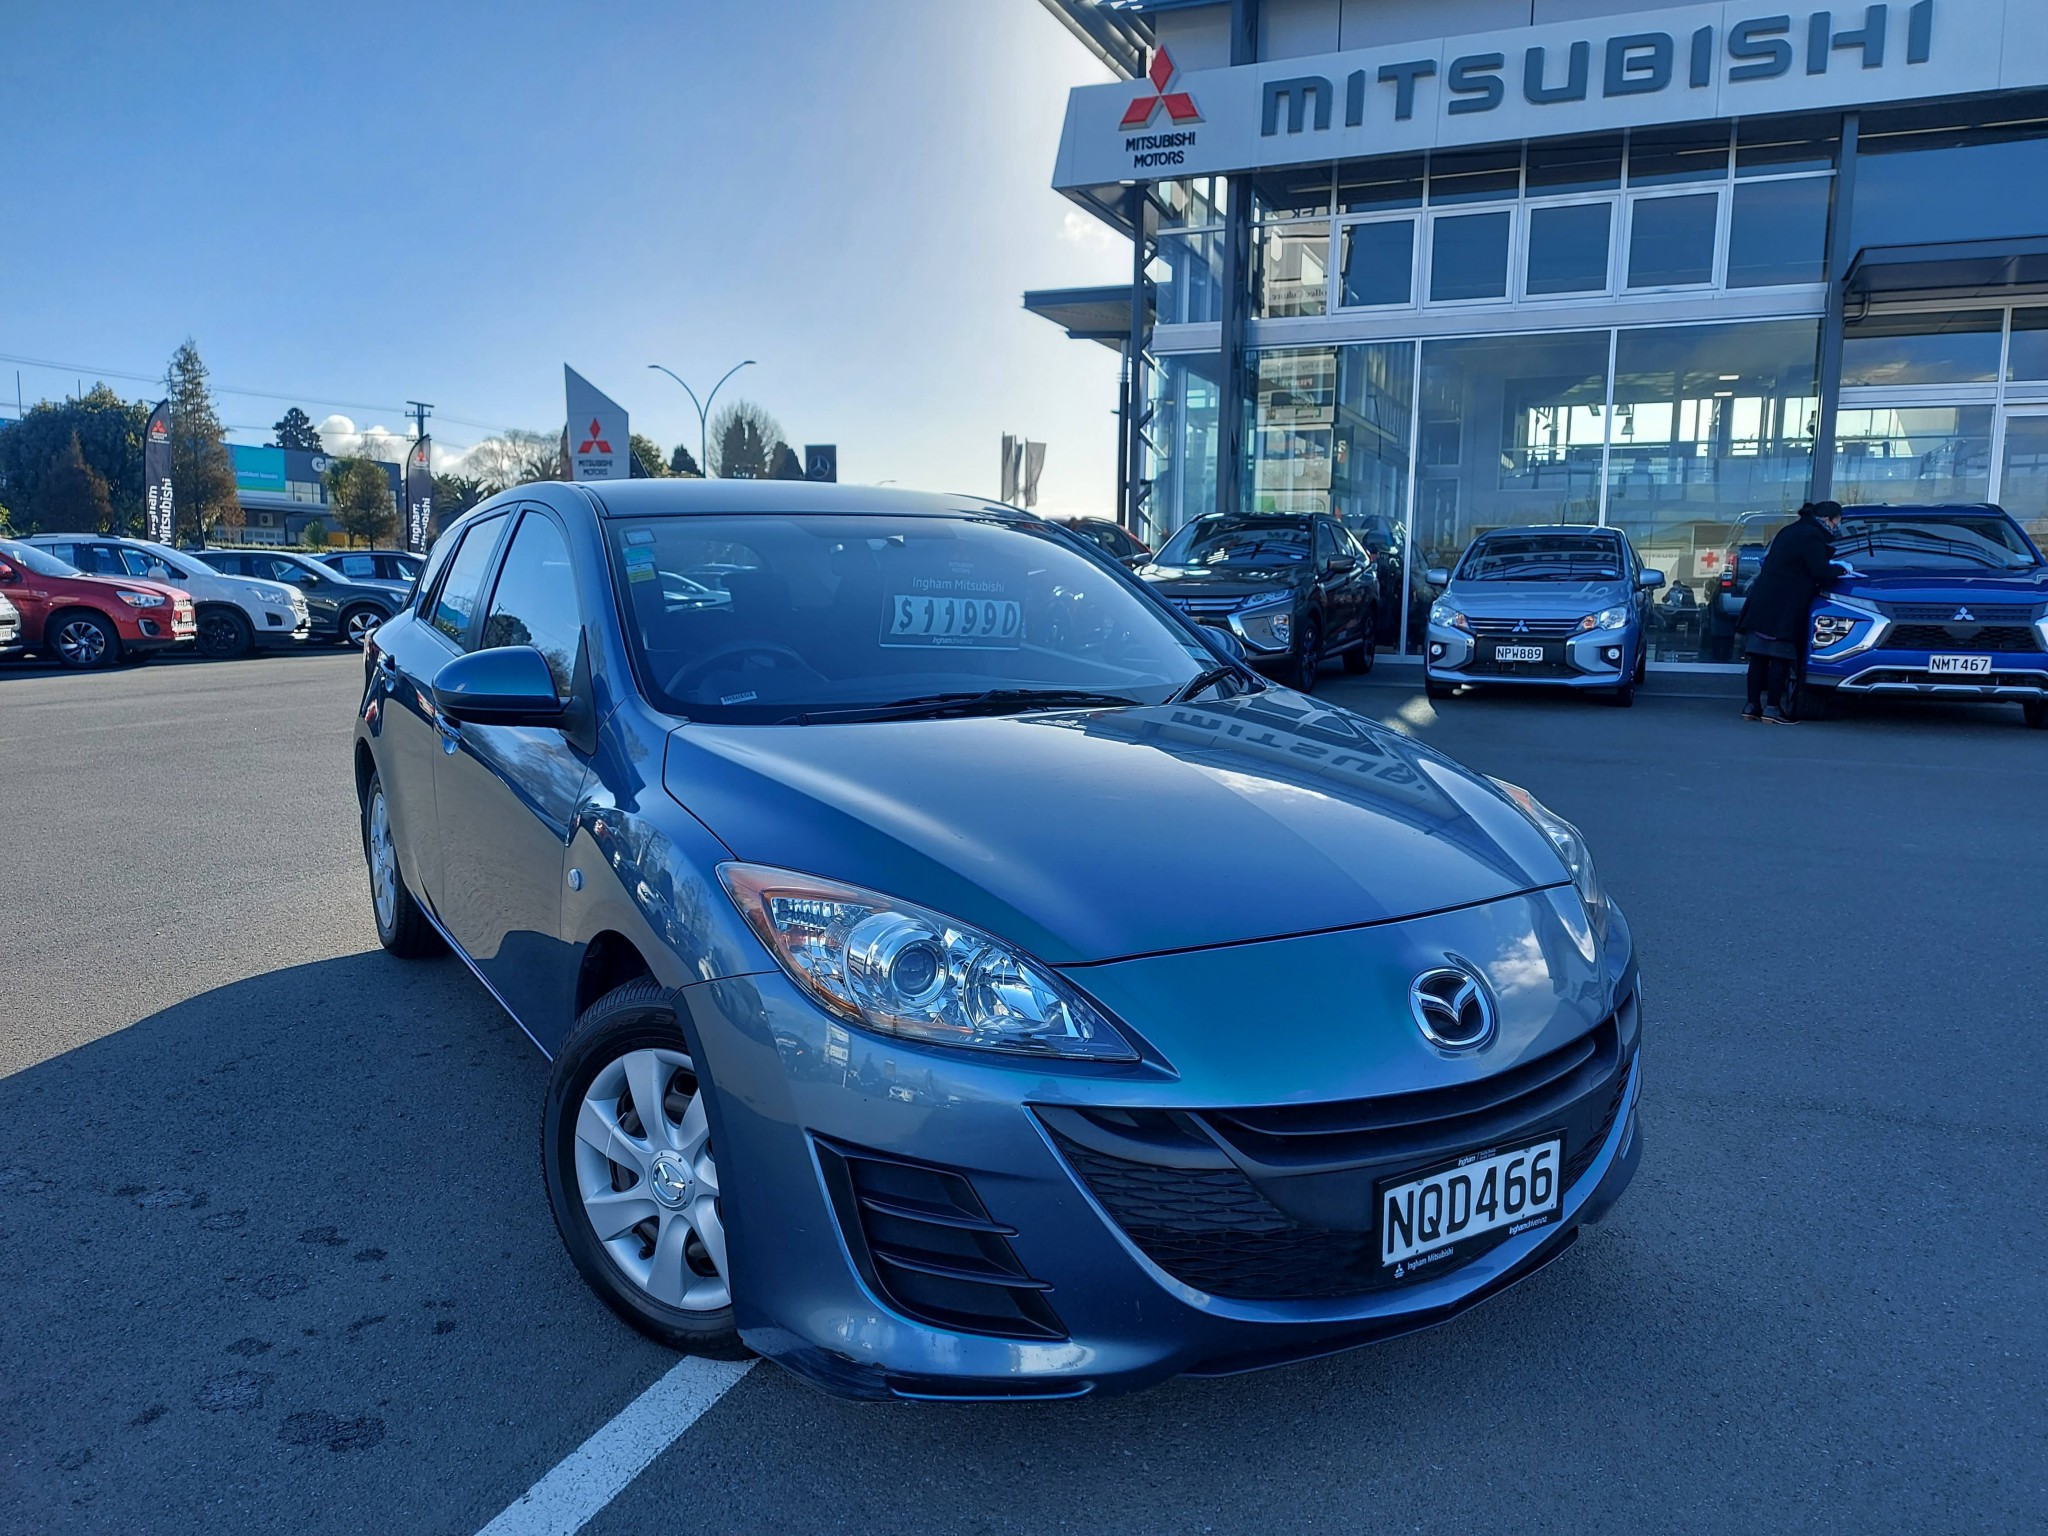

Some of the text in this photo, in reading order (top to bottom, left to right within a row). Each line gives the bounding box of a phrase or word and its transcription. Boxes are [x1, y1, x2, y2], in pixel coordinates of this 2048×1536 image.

[1260, 0, 1933, 136] MITSUBISHI
[1125, 131, 1196, 152] MITSUBISHI
[1133, 150, 1185, 168] MOTORS
[578, 459, 613, 467] MITSUBISHI
[583, 468, 608, 476] MOTORS
[159, 477, 173, 546] Mitsubishi
[410, 503, 421, 544] Ingham
[912, 577, 1005, 592] Ingham Mitsubishi
[899, 597, 1017, 636] $11990
[1497, 647, 1542, 660] NPW889
[1931, 658, 1989, 672] NMT467
[1387, 1148, 1553, 1255] NQD466
[1407, 1246, 1454, 1271] Ingham Mitsubishi
